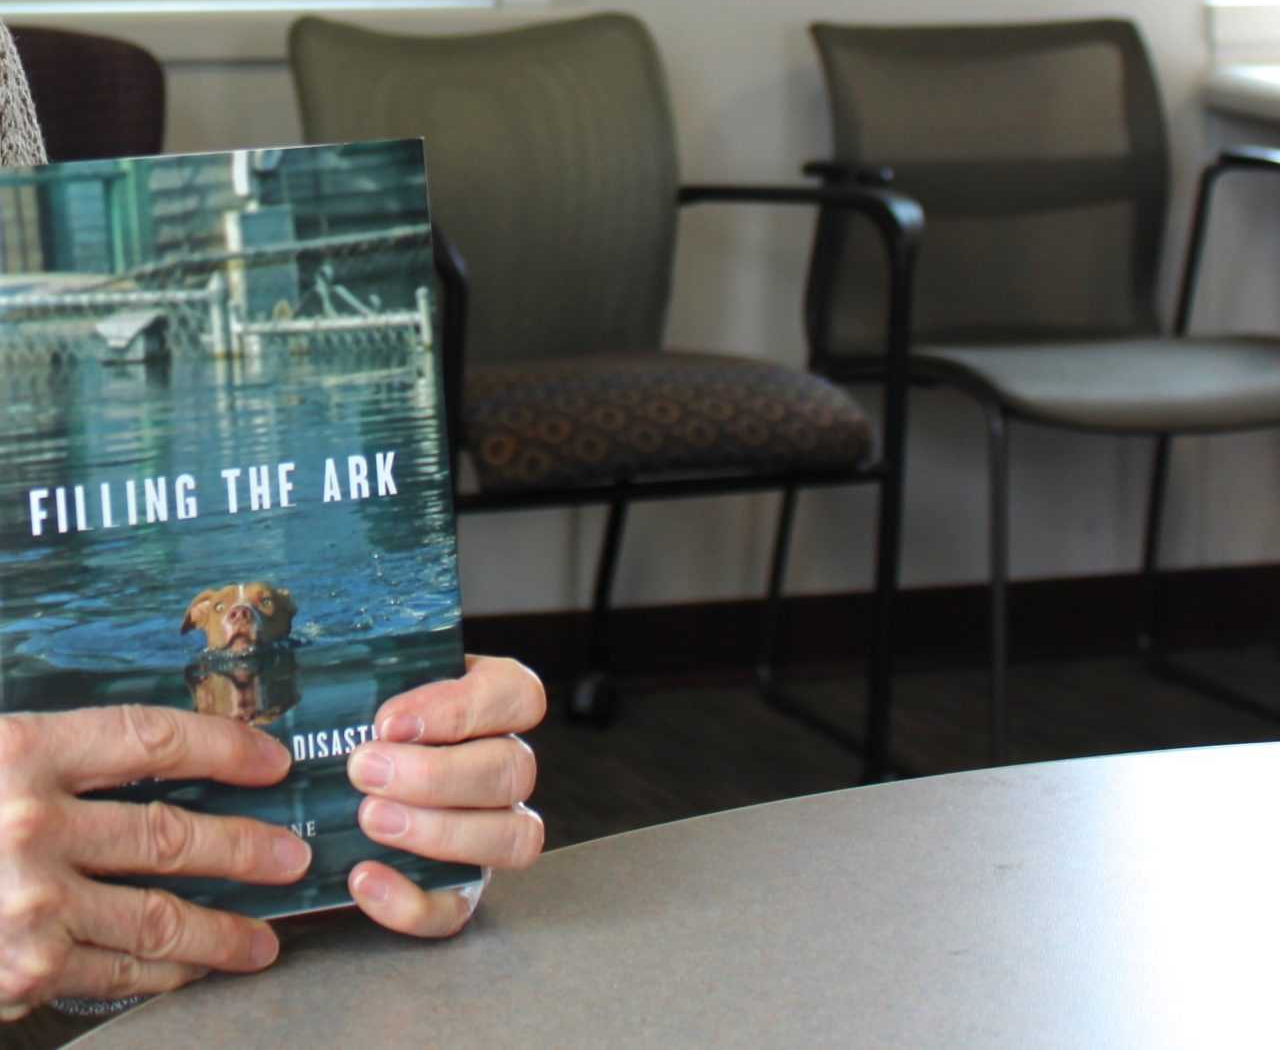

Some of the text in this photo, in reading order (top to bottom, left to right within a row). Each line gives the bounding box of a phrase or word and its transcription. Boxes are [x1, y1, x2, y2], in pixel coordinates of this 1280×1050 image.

[29, 451, 398, 536] FILLING THE ARK
[292, 724, 378, 762] DISAST
